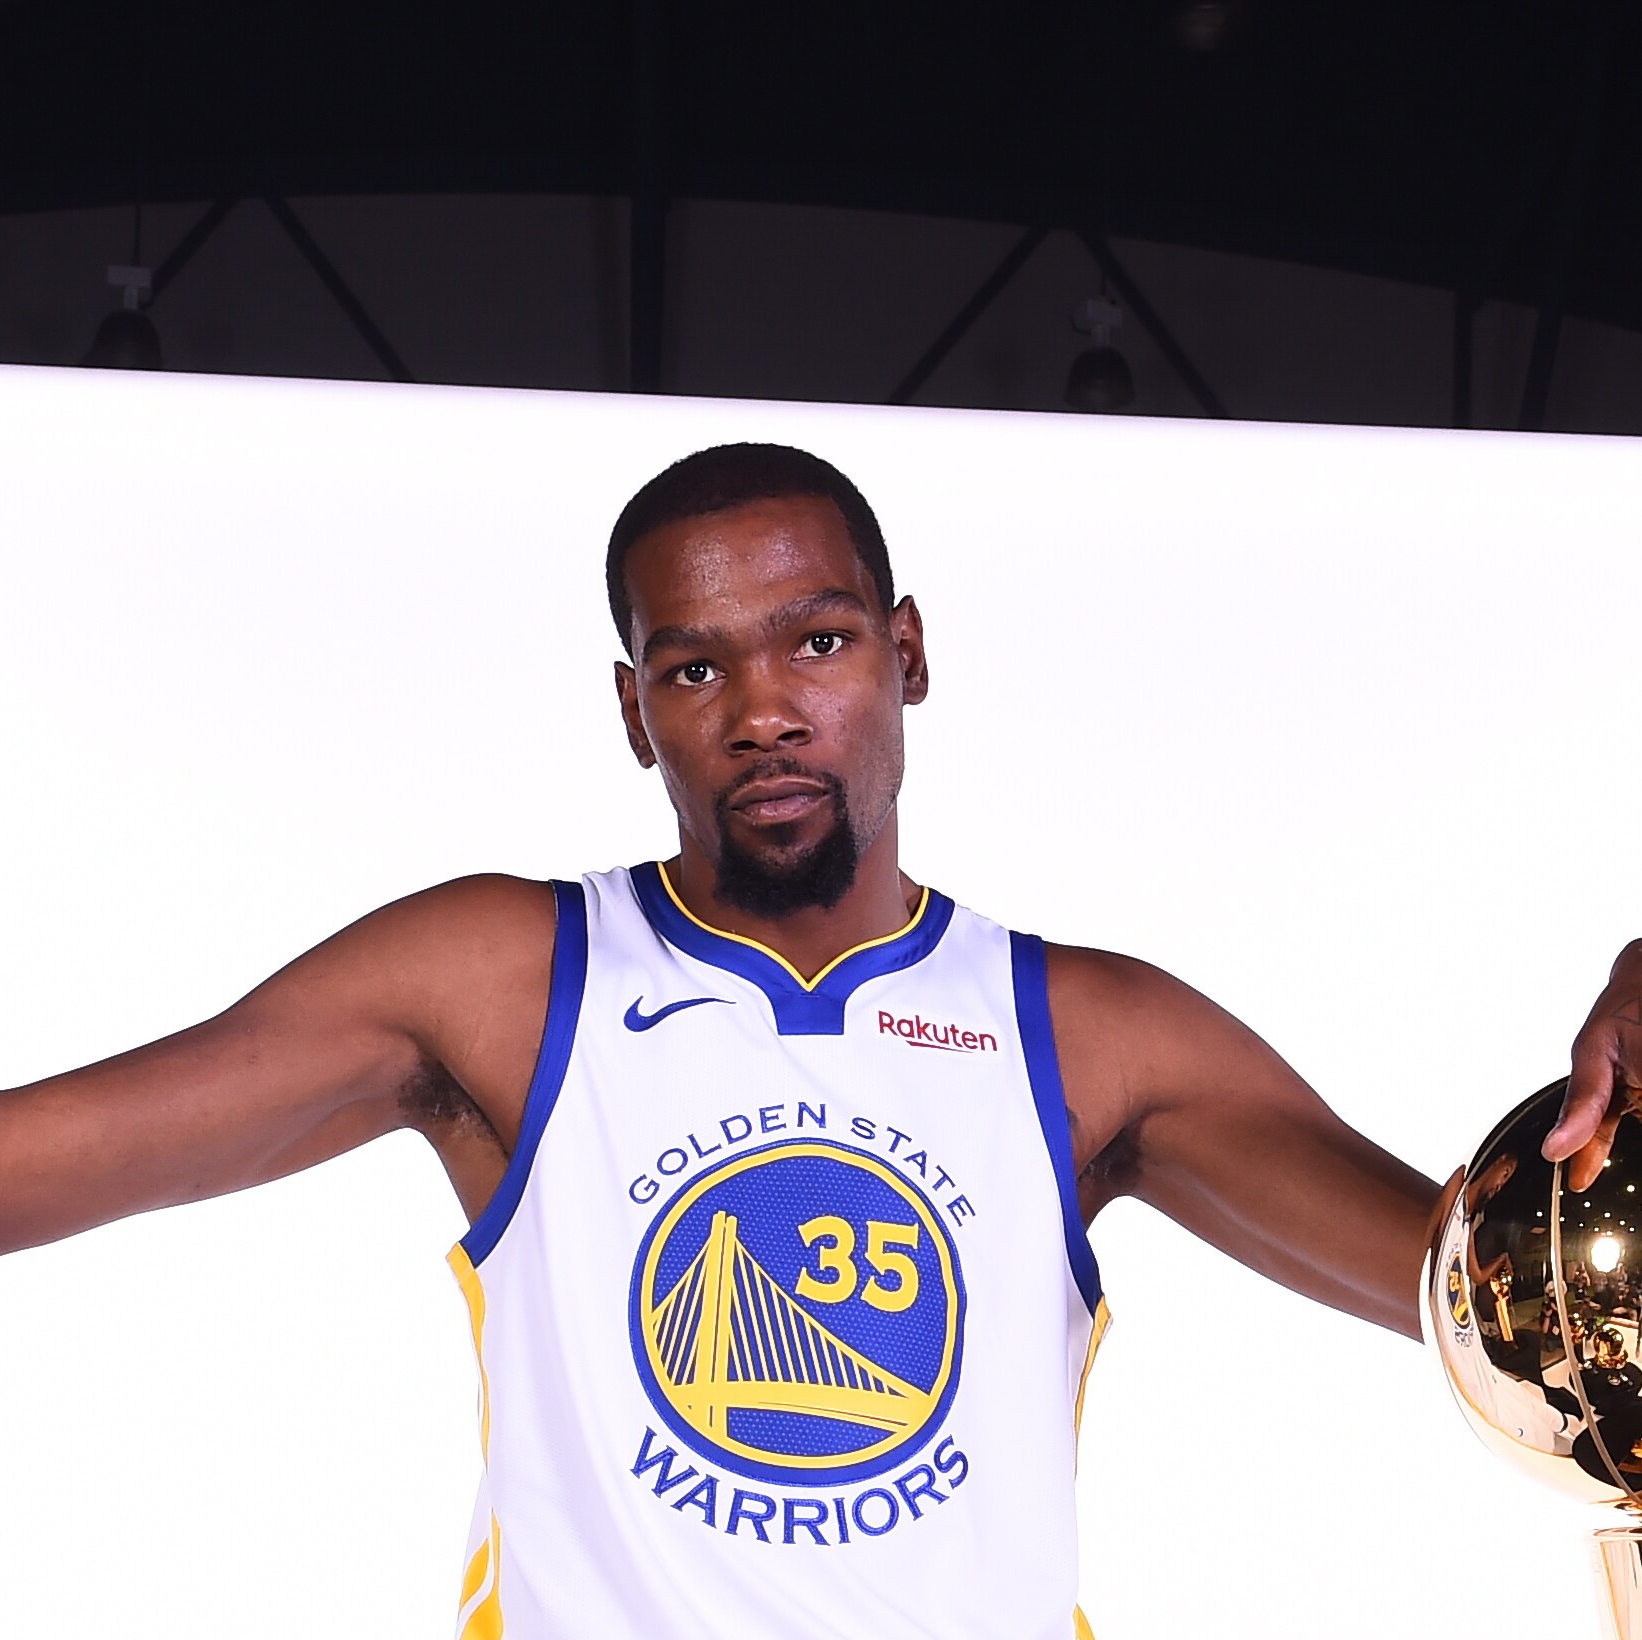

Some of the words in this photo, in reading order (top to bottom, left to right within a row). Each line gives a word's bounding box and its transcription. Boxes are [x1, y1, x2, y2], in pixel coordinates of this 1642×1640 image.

[878, 1010, 998, 1052] Rakuten
[628, 1101, 827, 1205] GOLDEN
[850, 1116, 976, 1227] STATE
[795, 1215, 920, 1312] 35
[630, 1426, 969, 1546] WARRIORS
